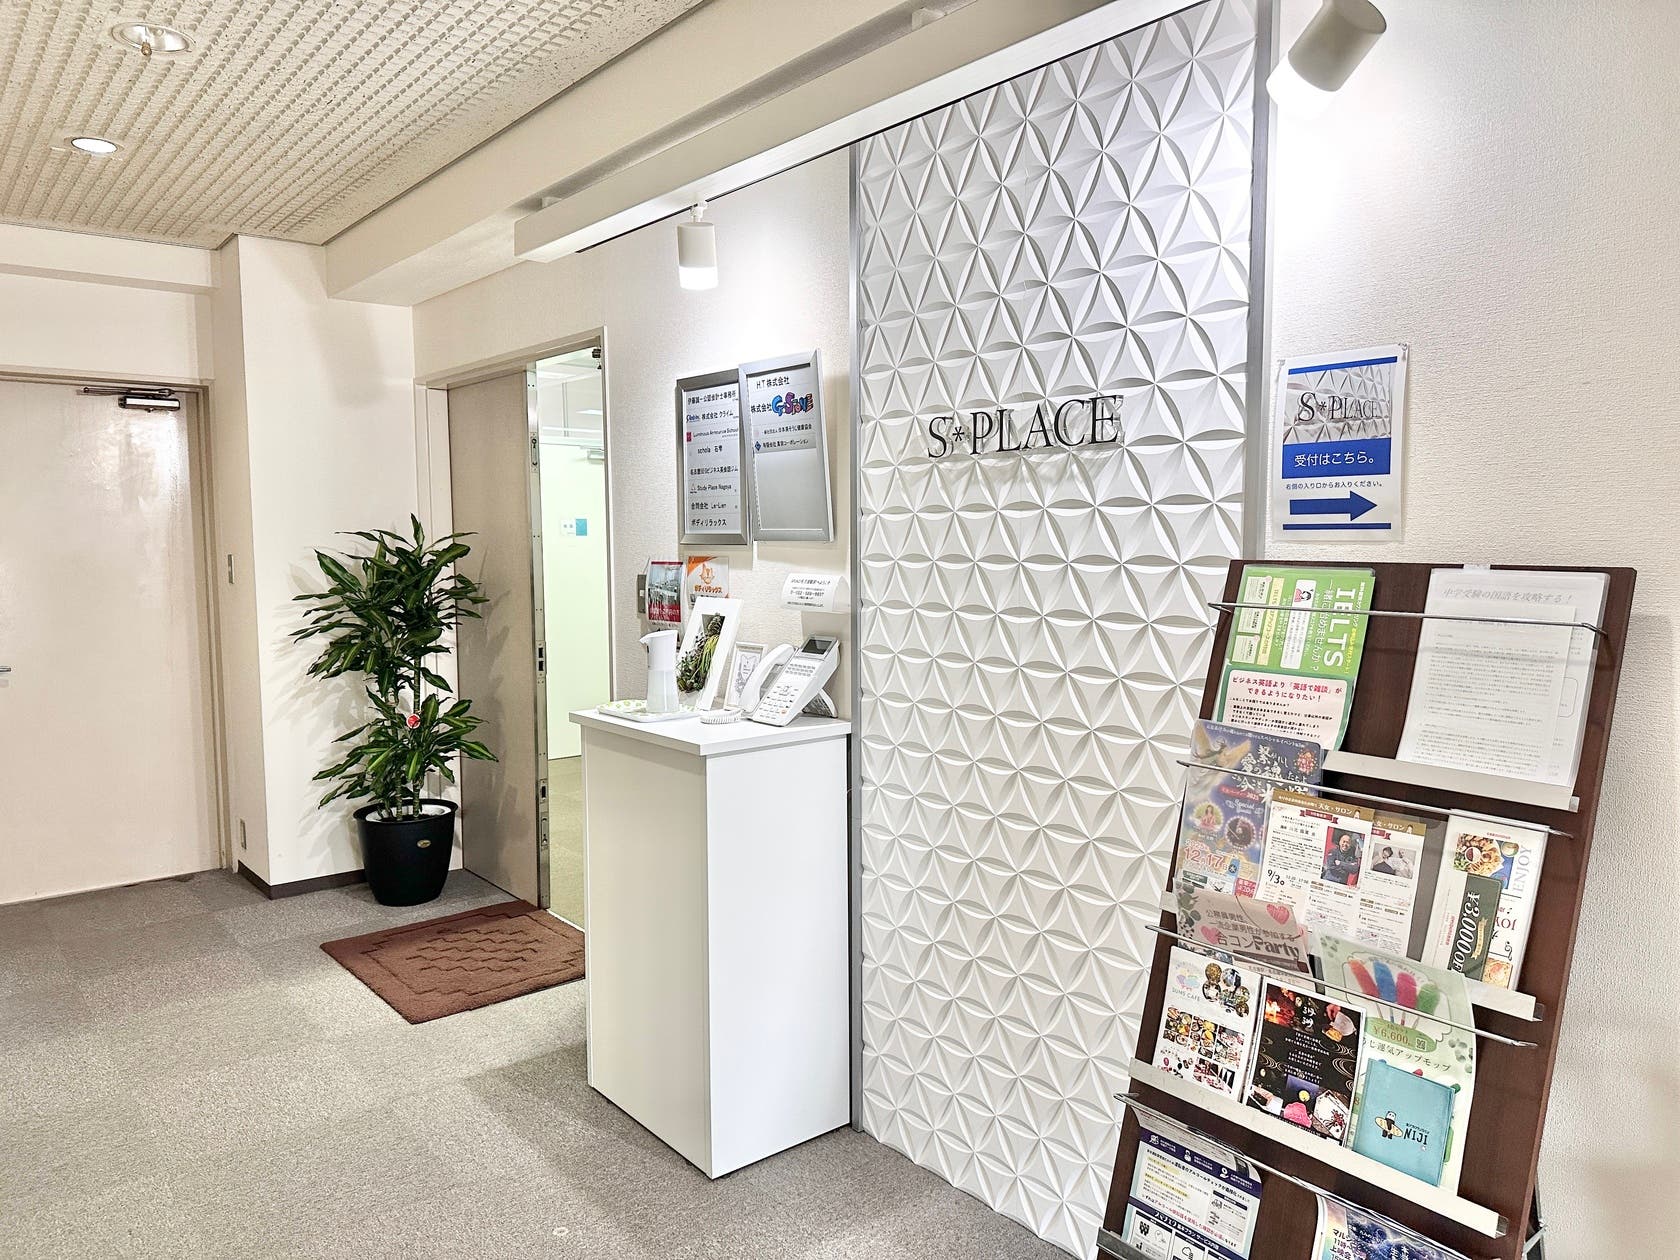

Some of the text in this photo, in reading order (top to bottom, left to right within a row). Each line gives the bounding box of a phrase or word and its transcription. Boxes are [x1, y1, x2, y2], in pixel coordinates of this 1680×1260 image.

[1294, 451, 1375, 468] 受付はこちら。
[1285, 480, 1383, 491] 右側の入り口からお入りください。
[1443, 587, 1573, 605] 中学受験の国語を攻略する！
[1247, 687, 1322, 703] できるようになりたい！
[1403, 1127, 1428, 1146] NIJI
